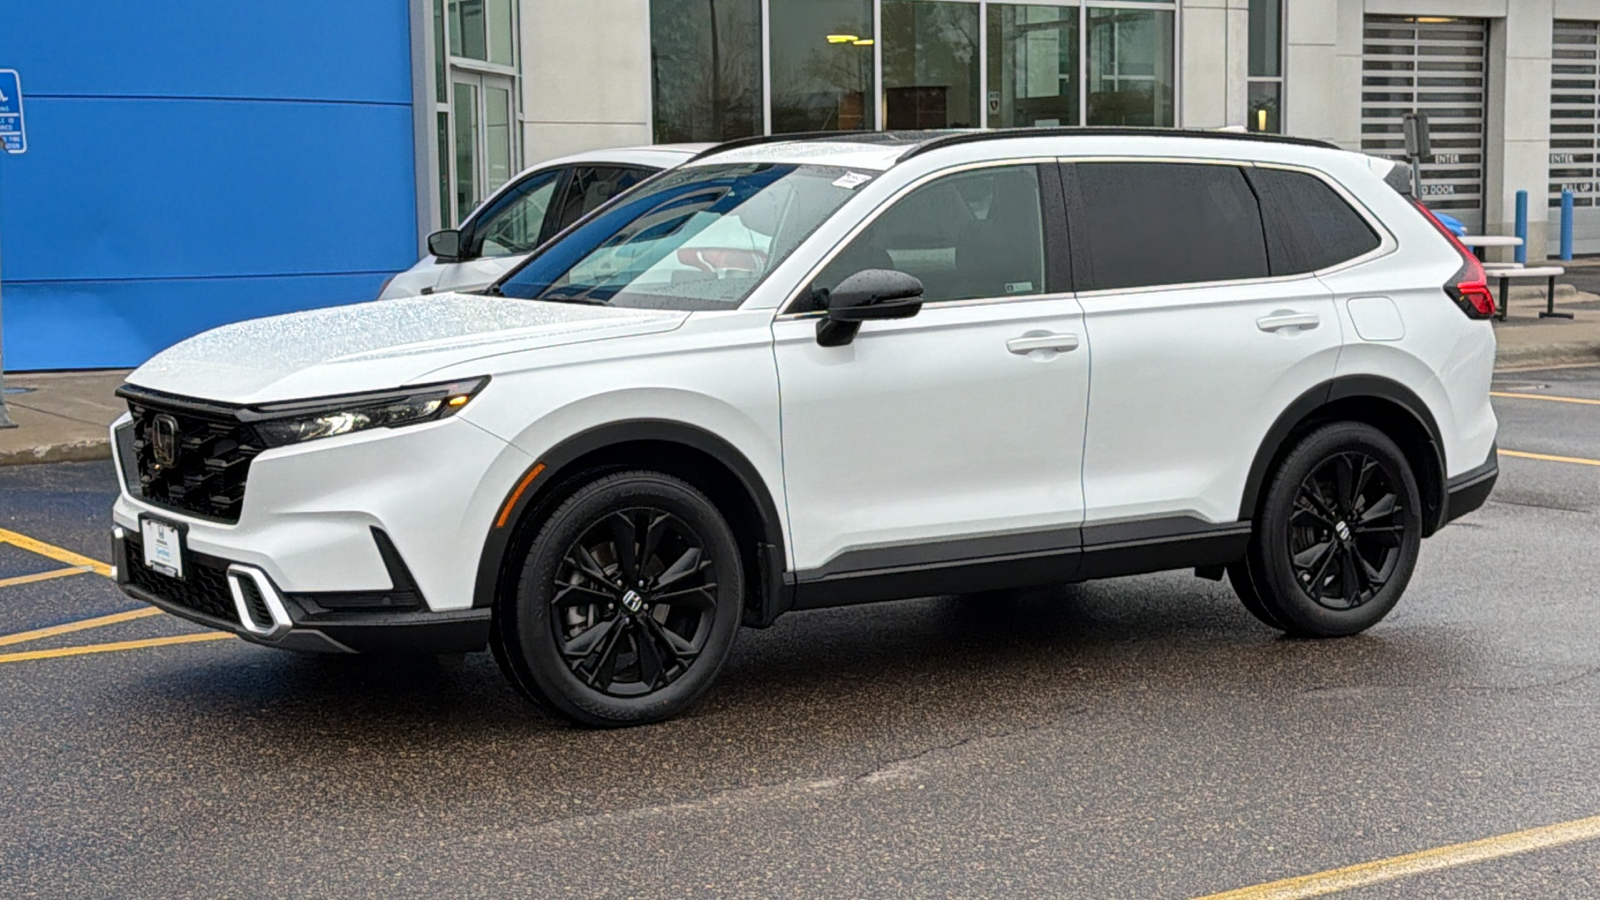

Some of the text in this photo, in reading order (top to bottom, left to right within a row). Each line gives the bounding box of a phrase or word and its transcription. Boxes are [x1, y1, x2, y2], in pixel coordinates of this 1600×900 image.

[1435, 154, 1459, 164] ENTER
[1550, 153, 1574, 164] ENTER
[1430, 185, 1455, 195] DOOR
